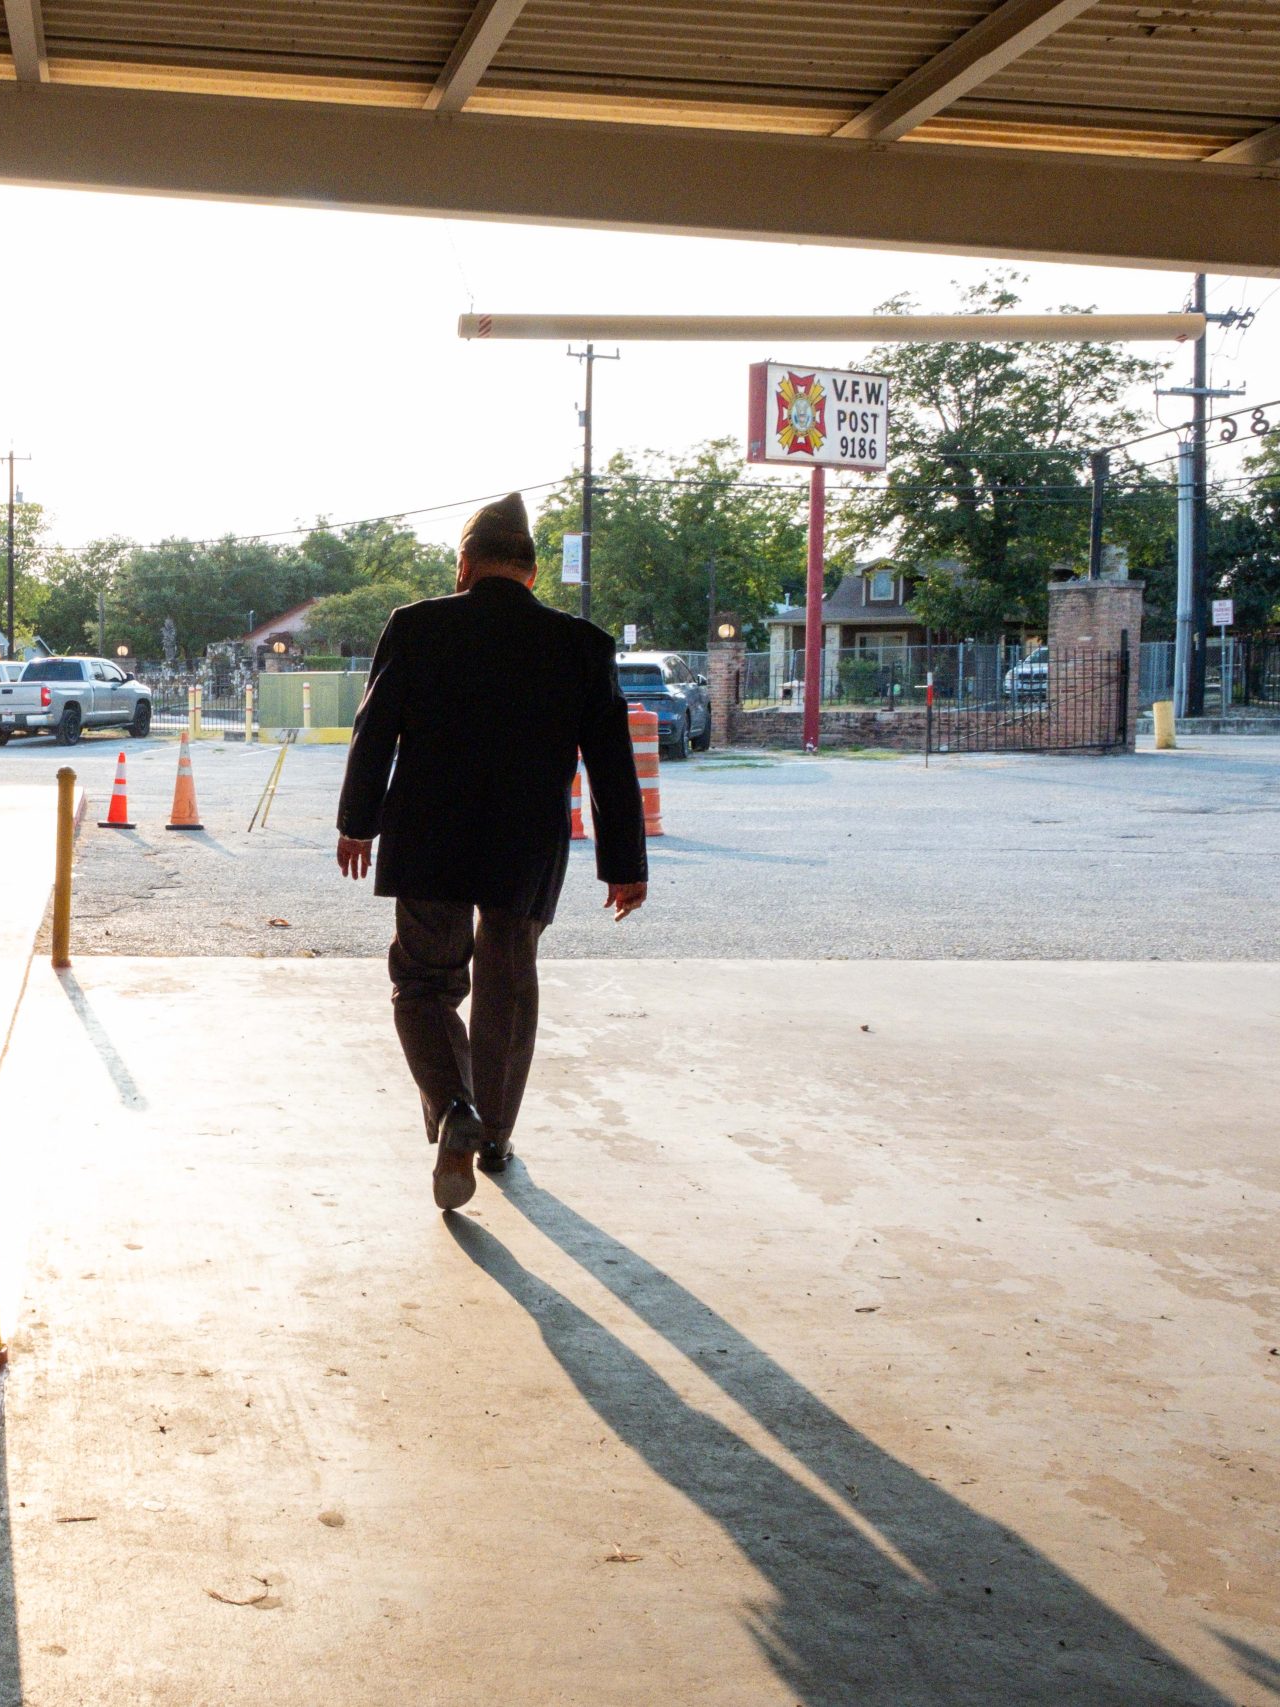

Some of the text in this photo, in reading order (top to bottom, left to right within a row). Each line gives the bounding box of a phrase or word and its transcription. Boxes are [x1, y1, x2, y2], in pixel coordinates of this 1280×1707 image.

[832, 378, 885, 406] V.F.W.
[837, 410, 879, 434] POST
[840, 436, 877, 460] 9186
